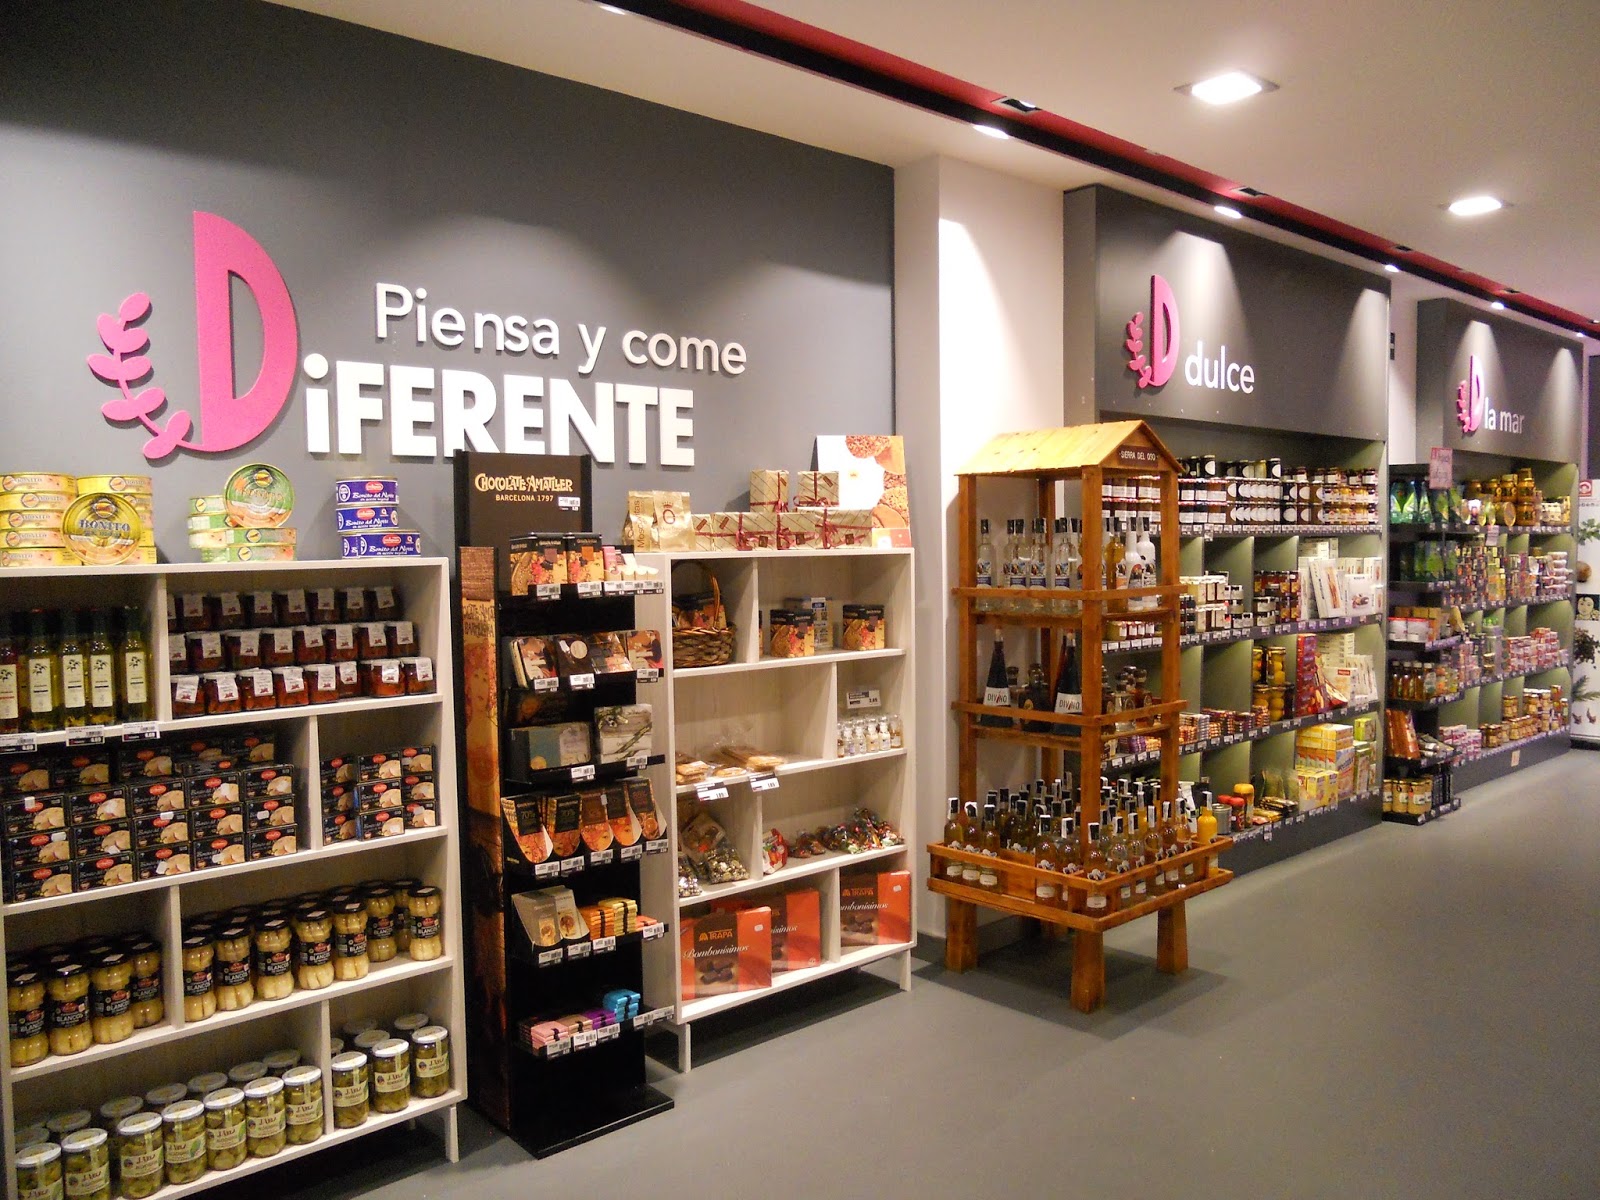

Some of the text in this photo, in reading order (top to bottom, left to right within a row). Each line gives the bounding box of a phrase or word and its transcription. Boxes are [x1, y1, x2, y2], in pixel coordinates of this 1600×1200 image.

[375, 281, 749, 375] Piensa y come
[1184, 341, 1255, 394] dulce
[1484, 396, 1496, 430] la
[1500, 410, 1524, 434] mar
[79, 519, 131, 532] BONITO
[987, 696, 1008, 704] DIVINO
[1058, 700, 1080, 710] DIVINO
[708, 929, 733, 940] TRAPA
